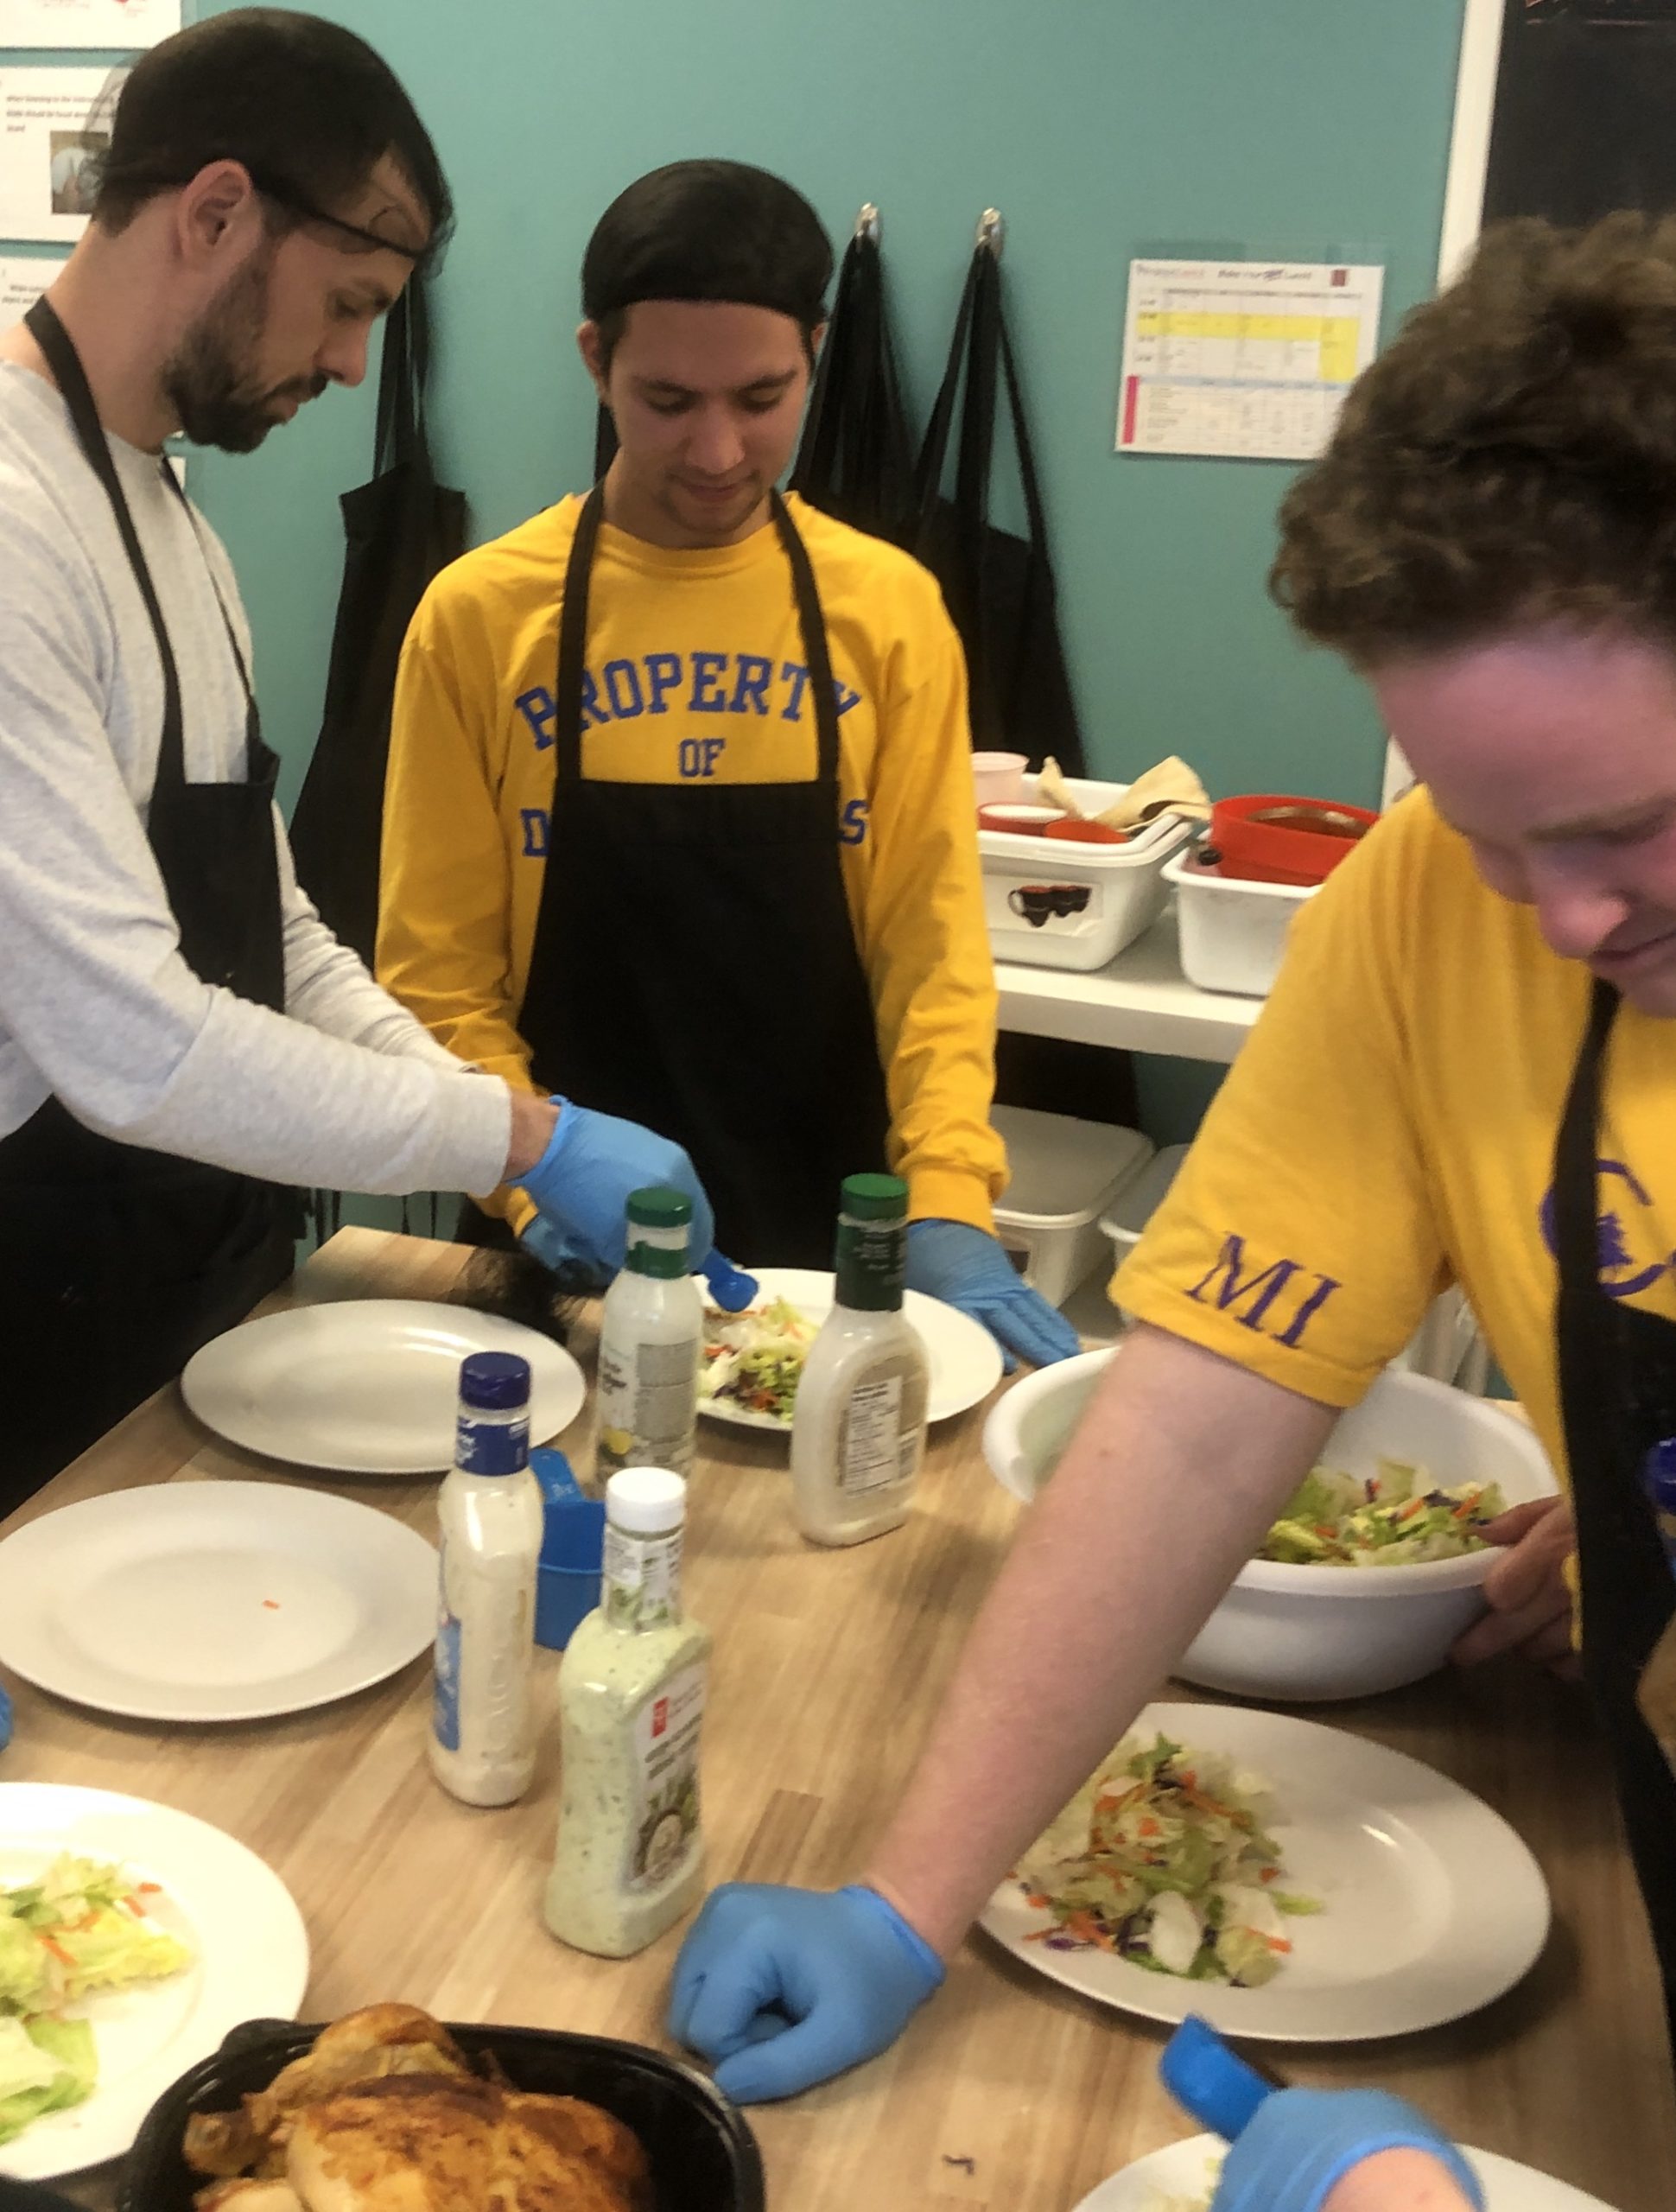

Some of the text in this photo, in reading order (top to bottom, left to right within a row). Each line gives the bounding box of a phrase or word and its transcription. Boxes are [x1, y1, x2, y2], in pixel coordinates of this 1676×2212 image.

[515, 651, 861, 751] PROPERTY
[678, 737, 726, 778] OF
[1183, 1231, 1343, 1350] MI
